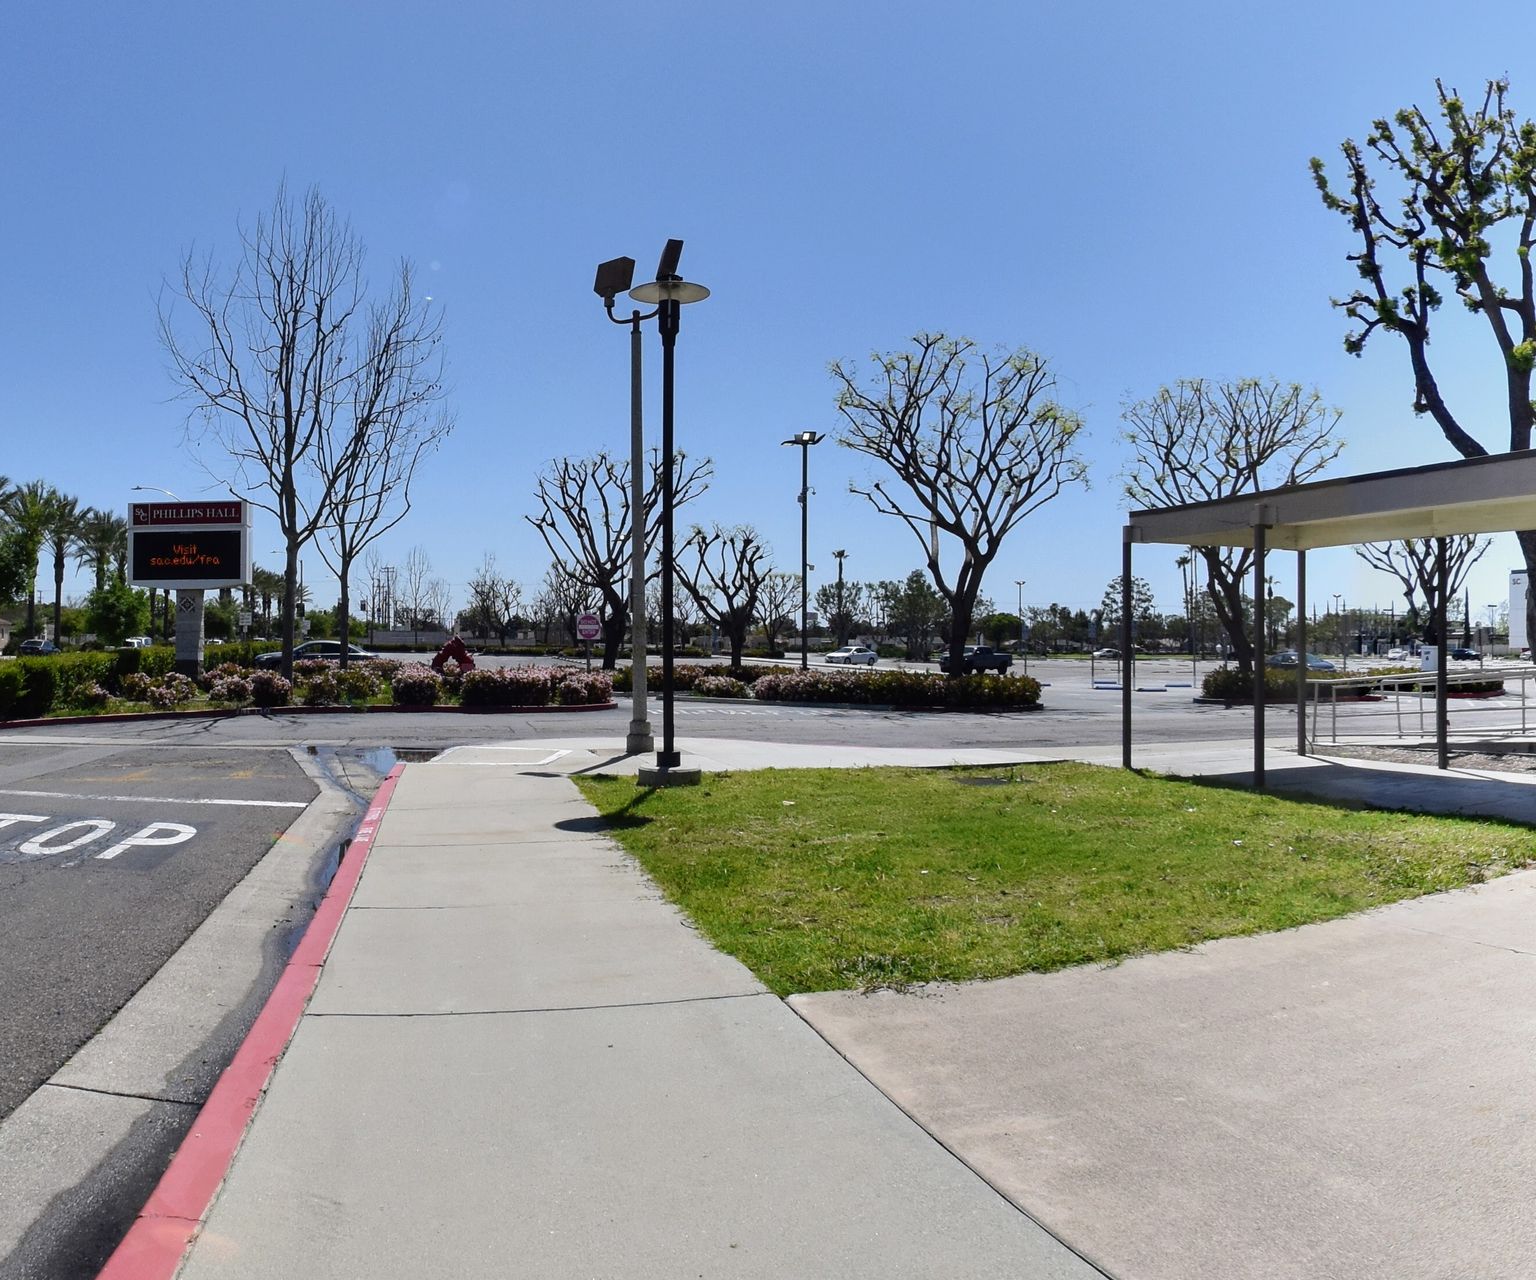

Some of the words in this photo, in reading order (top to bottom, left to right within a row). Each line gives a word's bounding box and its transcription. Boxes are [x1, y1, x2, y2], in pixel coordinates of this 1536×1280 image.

[153, 508, 204, 519] PHILLIPS
[206, 508, 239, 518] HALL
[173, 544, 197, 555] Visit
